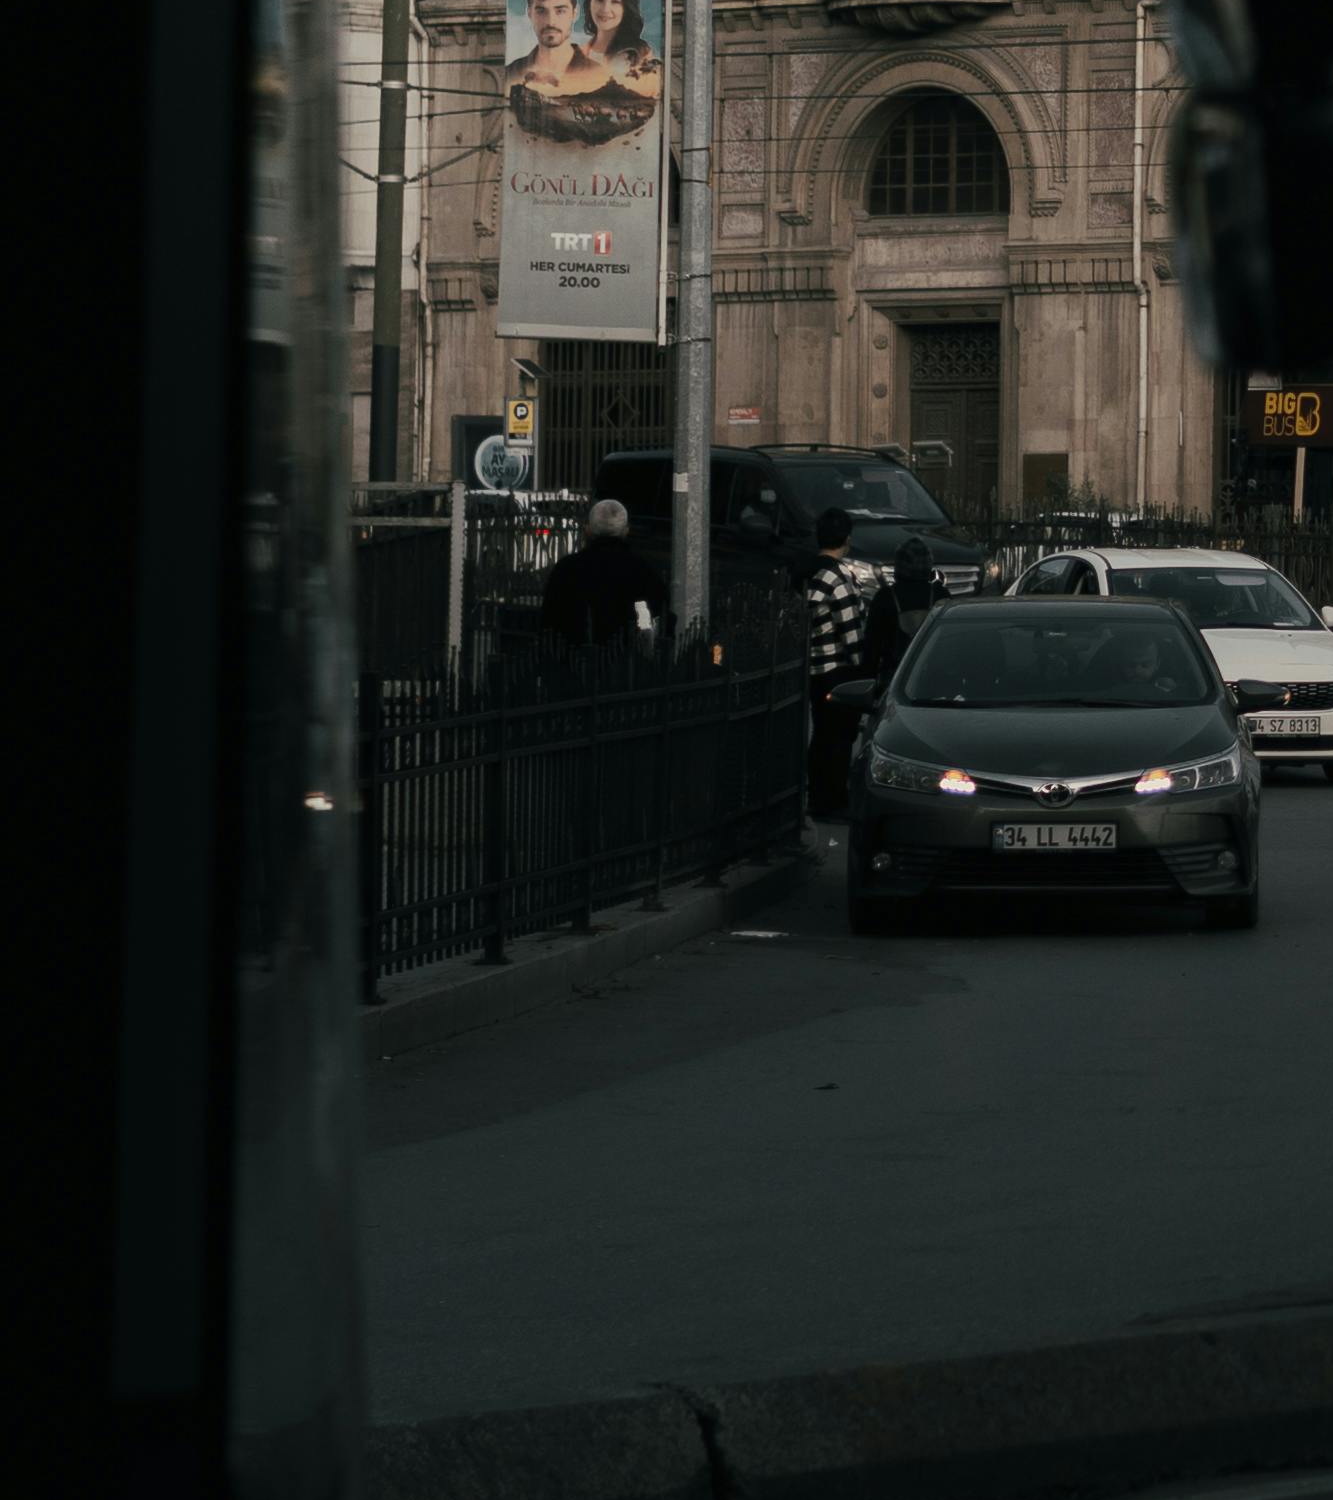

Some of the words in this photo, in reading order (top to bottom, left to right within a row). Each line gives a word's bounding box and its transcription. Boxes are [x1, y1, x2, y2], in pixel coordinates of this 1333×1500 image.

[511, 171, 585, 197] GÖNÜL
[591, 172, 655, 198] DAĞI
[551, 232, 592, 251] TRT
[530, 261, 555, 272] HER
[558, 263, 630, 275] CUMARTESİ
[558, 276, 600, 288] 20.00
[1264, 392, 1296, 415] BIG
[1263, 416, 1295, 437] BUS
[1270, 719, 1284, 732] SZ
[1289, 719, 1317, 732] 8313
[1005, 827, 1027, 846] 34
[1036, 827, 1059, 846] LL
[1068, 826, 1113, 846] 4442
